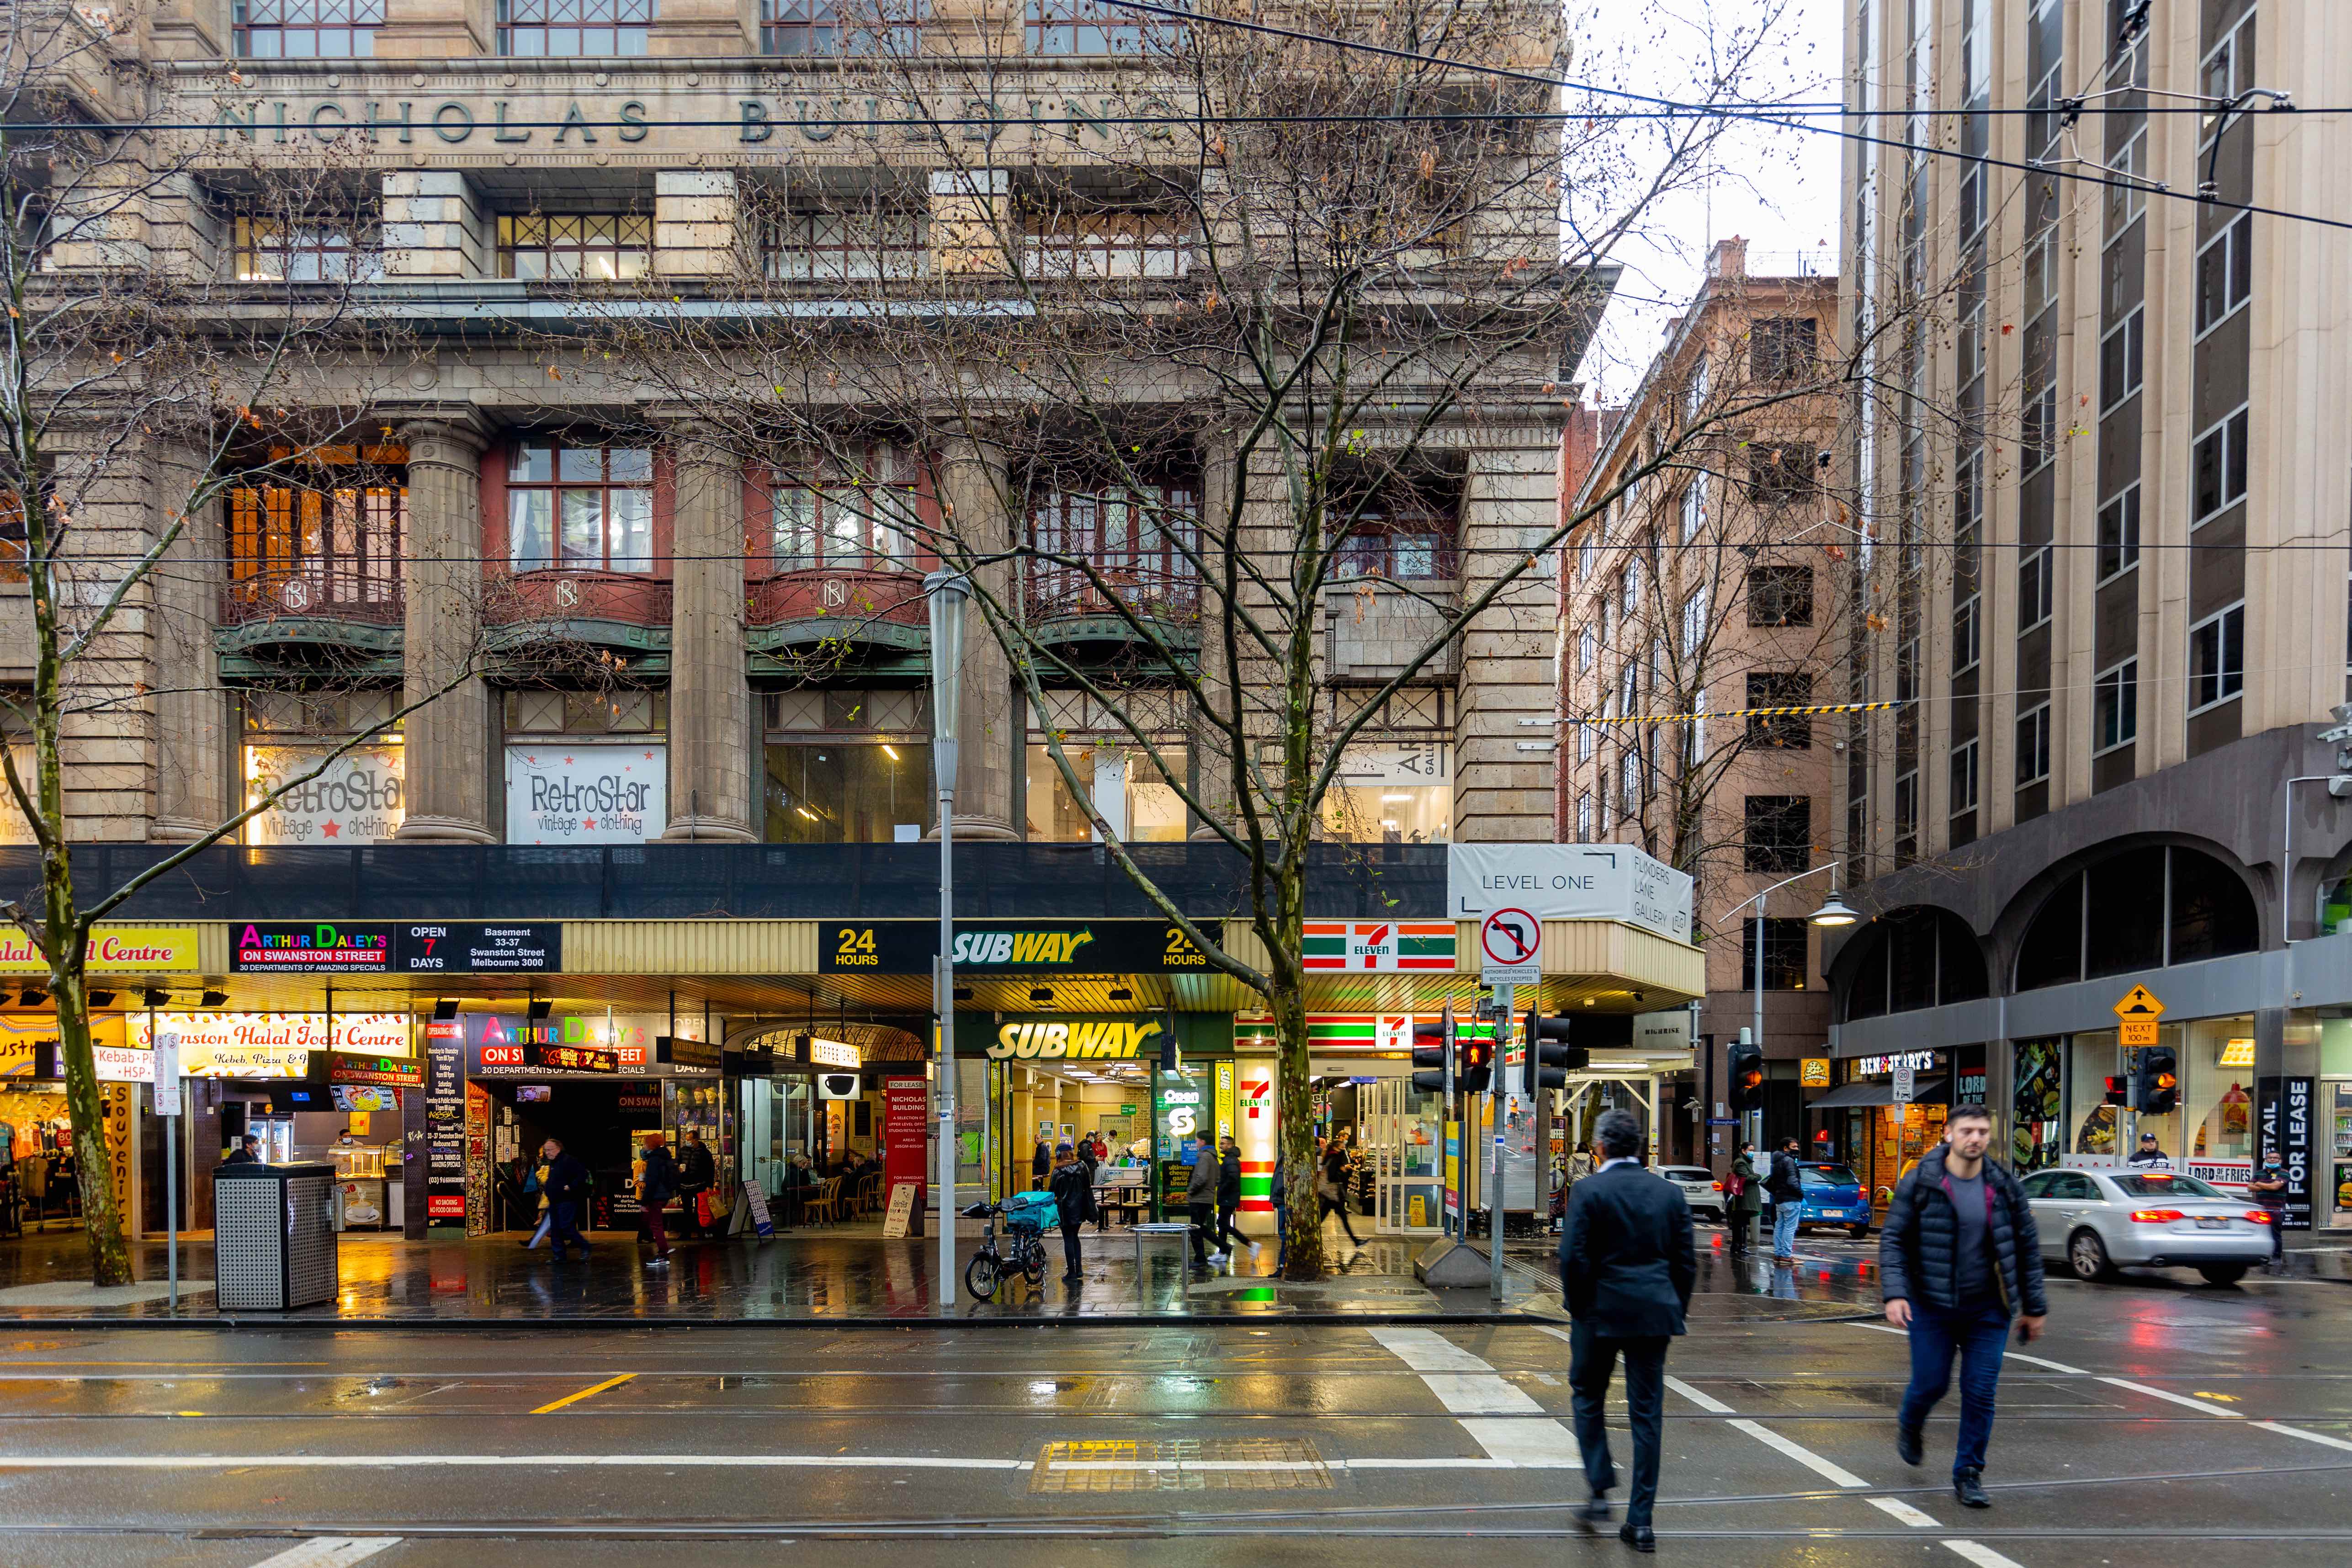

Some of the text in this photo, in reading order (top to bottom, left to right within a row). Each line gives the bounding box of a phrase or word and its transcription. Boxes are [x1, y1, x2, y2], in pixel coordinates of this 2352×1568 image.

[218, 99, 1173, 143] NICHOLAS BUILDING
[531, 775, 651, 813] RetroStar
[265, 815, 398, 841] vintage clothing
[538, 813, 642, 836] vintage clothing
[1635, 856, 1670, 885] FLINDERS
[1483, 875, 1594, 890] LEVEL ONE
[1635, 878, 1655, 899] LANE
[1634, 902, 1667, 927] GALLERY
[239, 925, 387, 947] ARTHUR DALEY'S
[411, 927, 446, 937] OPEN
[838, 929, 876, 953] 24
[102, 937, 173, 961] Centre
[423, 938, 436, 957] 7
[952, 928, 1093, 963] SUBWAY
[1354, 924, 1389, 968] 7
[243, 951, 382, 961] ON SWANSTON STREET
[410, 958, 444, 968] DAYS
[836, 954, 879, 965] HOURS
[1163, 955, 1206, 965] HOURS
[139, 1026, 404, 1047] Snston Halal Food Centre
[428, 1027, 449, 1036] OPERATING
[482, 1016, 559, 1042] ARTHUR
[1383, 1016, 1405, 1046] 7
[986, 1020, 1161, 1059] SUBWAY
[99, 1050, 135, 1063] Kebab
[252, 1053, 281, 1065] Pizza
[287, 1052, 297, 1064] &
[331, 1055, 422, 1074] ARTHUR DALEY'S
[485, 1048, 514, 1062] ON
[124, 1067, 145, 1078] HSP
[1859, 1056, 1881, 1075] BEN
[350, 1071, 395, 1082] SWANSTON
[396, 1074, 419, 1082] STREET
[1959, 1075, 1986, 1094] LORD
[1164, 1090, 1199, 1104] Open
[1220, 1066, 1232, 1116] SUBWAY
[1240, 1080, 1269, 1119] 7
[1963, 1094, 1983, 1104] OF THE
[2290, 1081, 2307, 1146] LEASE
[2189, 1167, 2215, 1181] LORD
[2225, 1168, 2251, 1182] FRIES
[2288, 1152, 2306, 1194] FOR
[745, 1180, 761, 1189] COFFEE
[747, 1187, 763, 1196] COFFEE
[749, 1194, 765, 1203] COFFEE
[751, 1201, 767, 1210] COFFEE
[753, 1208, 769, 1217] COFFEE
[755, 1215, 771, 1225] COFFEE
